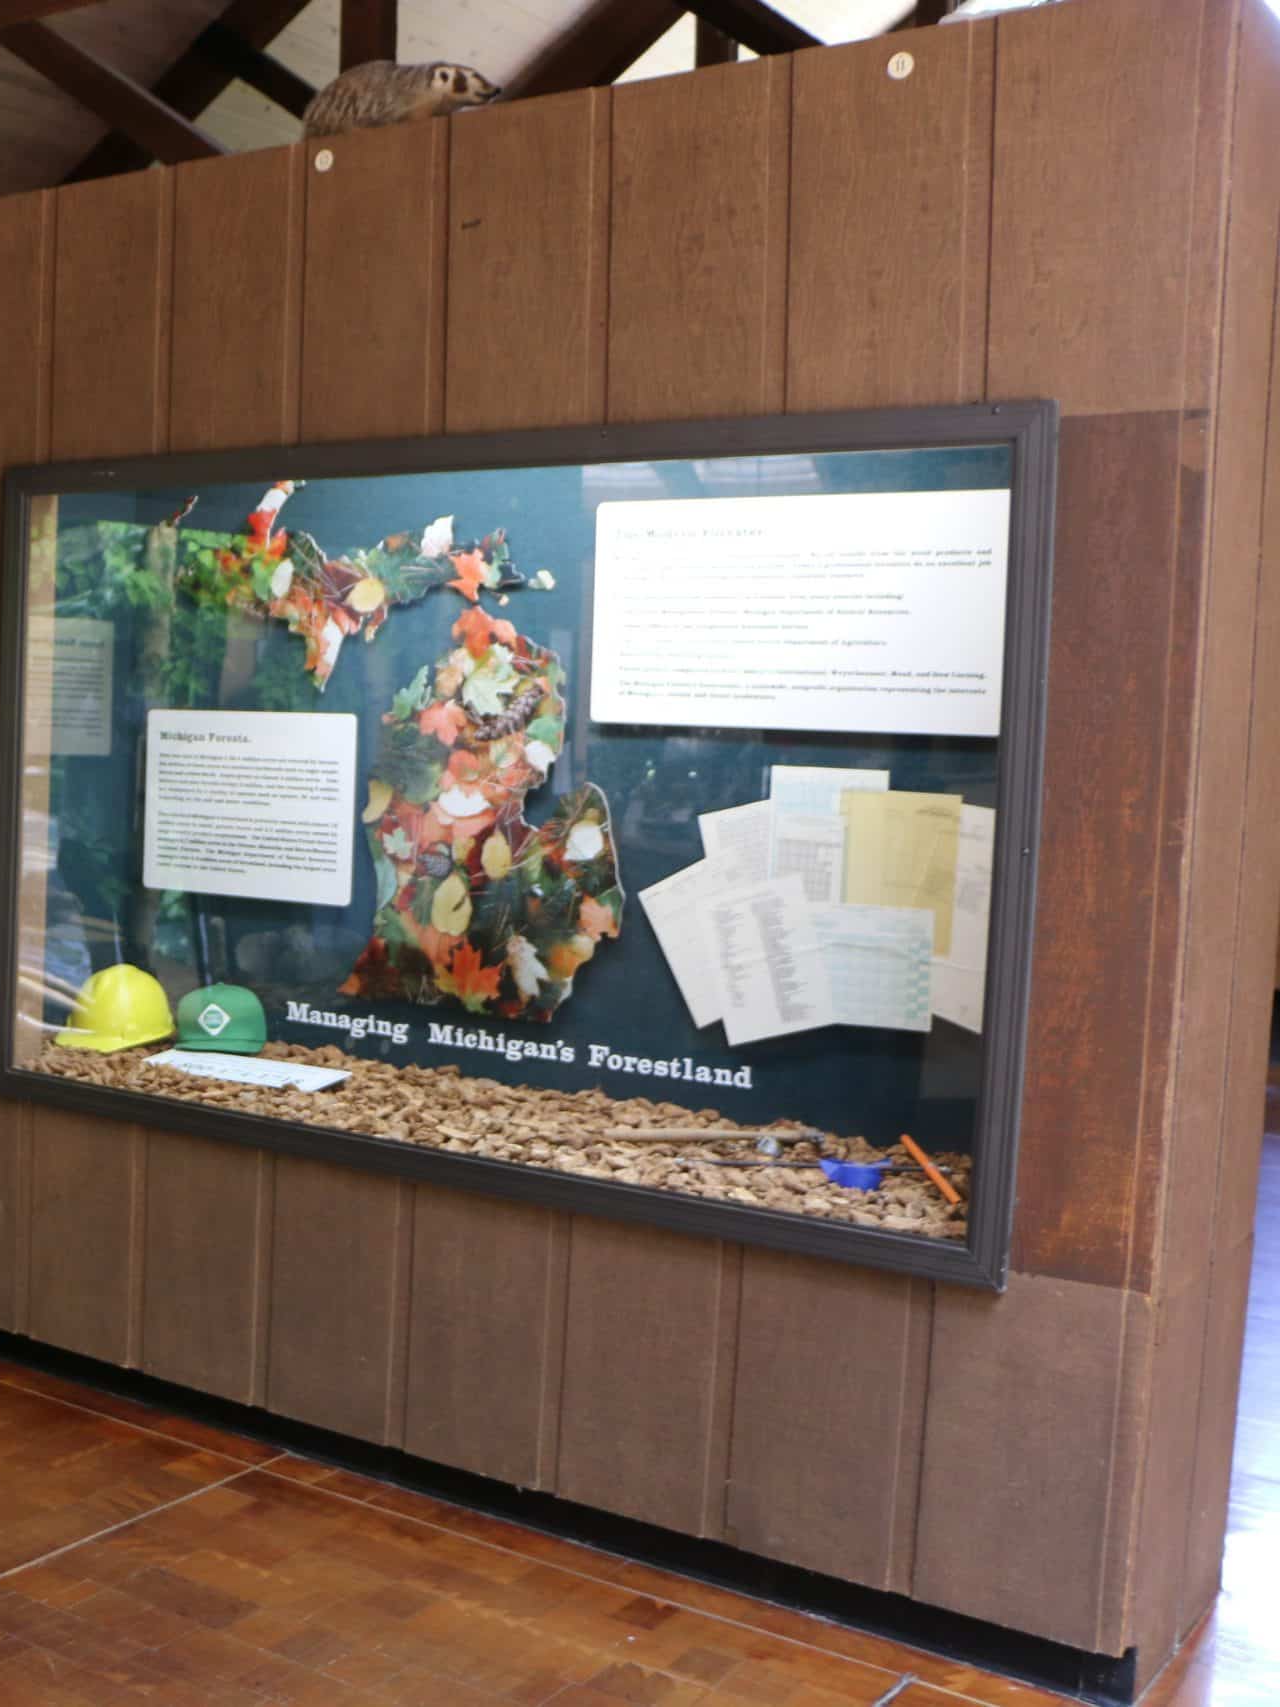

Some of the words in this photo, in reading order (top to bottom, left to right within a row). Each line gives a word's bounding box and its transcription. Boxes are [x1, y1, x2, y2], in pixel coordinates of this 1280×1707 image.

[208, 731, 253, 744] Forests.
[285, 1000, 410, 1044] Managing
[427, 1022, 576, 1064] Michigan's
[586, 1043, 754, 1089] Forestland
